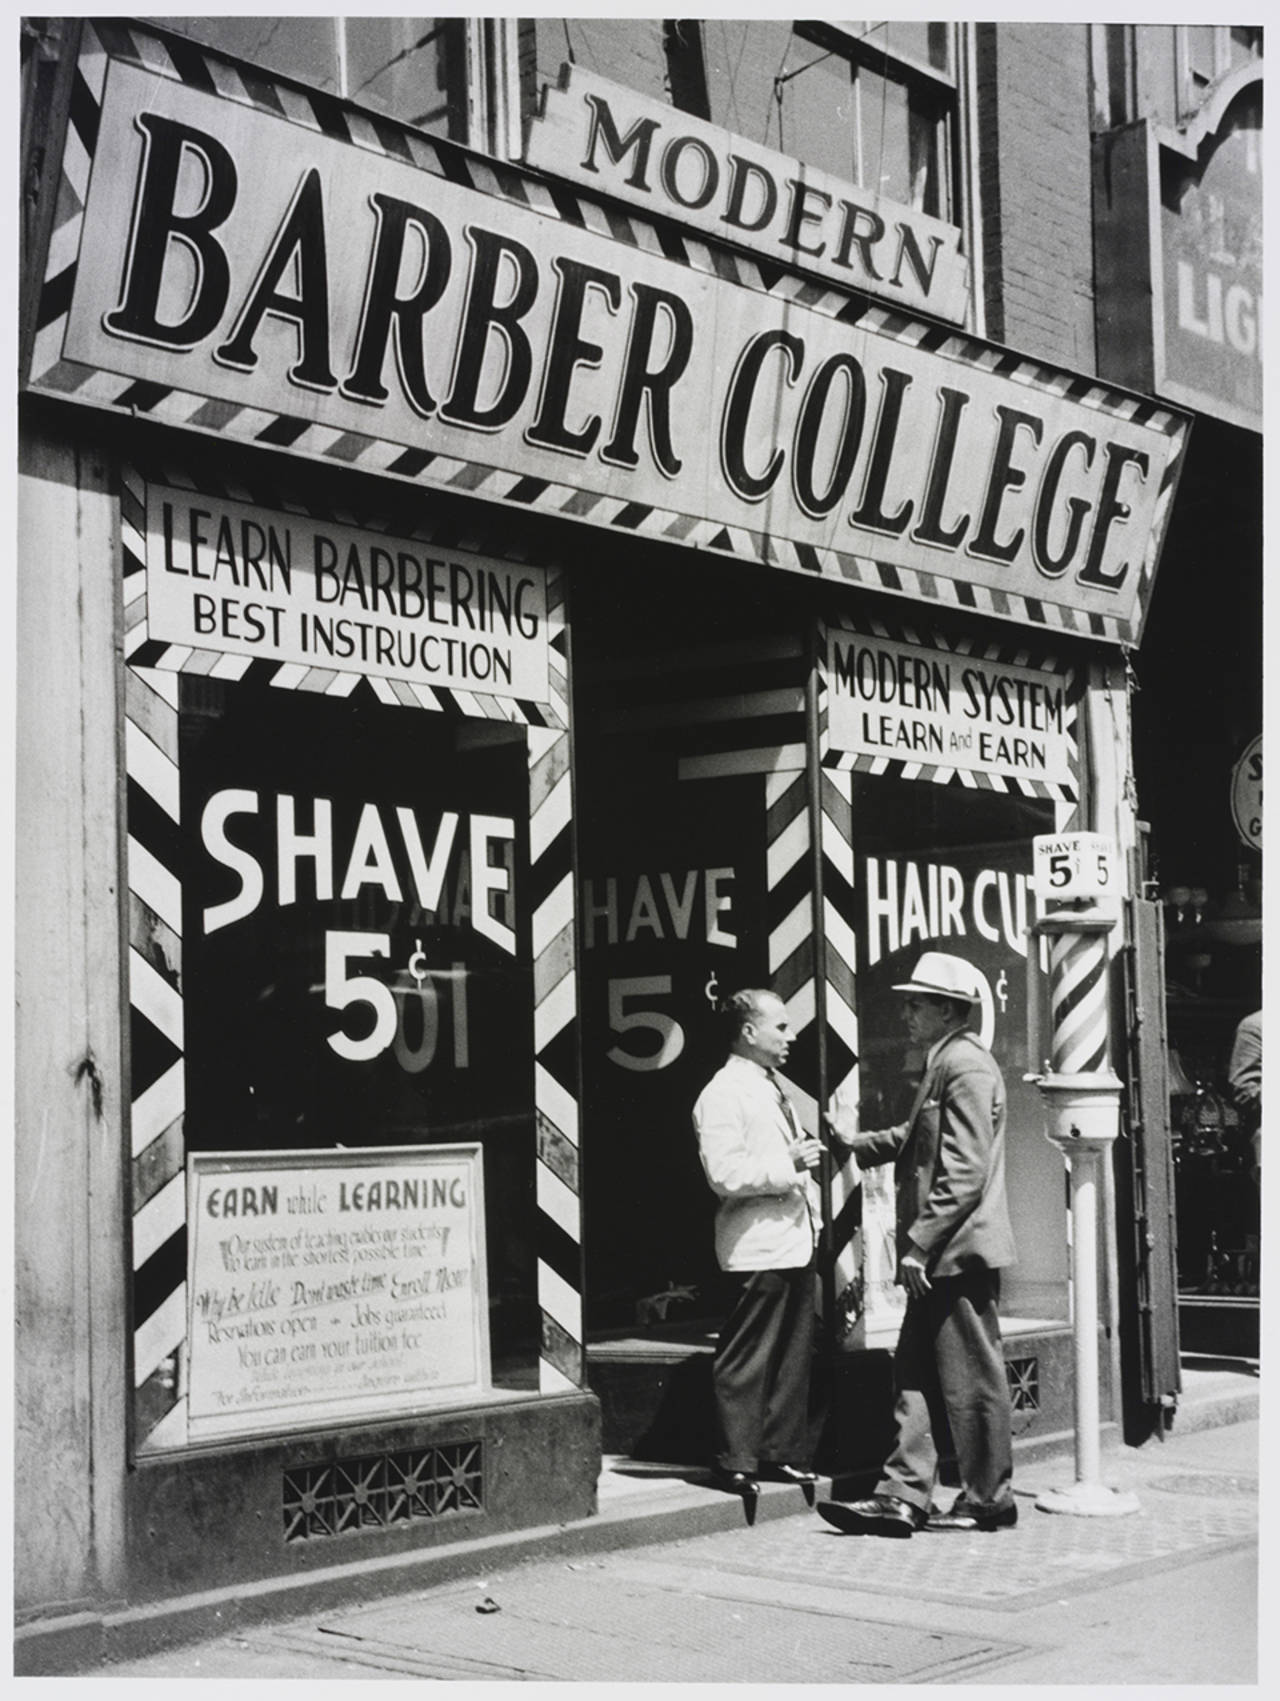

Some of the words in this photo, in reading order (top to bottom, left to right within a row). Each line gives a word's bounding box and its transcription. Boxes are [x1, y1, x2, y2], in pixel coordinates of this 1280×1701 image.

[581, 93, 944, 297] MODERN
[103, 112, 694, 478] BARBER
[720, 329, 1149, 591] COLLEGE
[1178, 260, 1263, 356] LIG
[162, 502, 291, 594] LEARN
[314, 535, 539, 639] BARBERING
[194, 594, 285, 647] BEST
[301, 613, 512, 684] INSTRUCTION
[834, 642, 950, 714] MODERN
[961, 668, 1063, 734] SYSTEM
[862, 712, 943, 753] LEARN
[950, 727, 972, 749] And
[979, 732, 1046, 769] EARN
[201, 789, 516, 956] SHAVE
[1038, 840, 1080, 855] SHAVE
[867, 857, 966, 966] HAIR
[207, 1186, 278, 1218] EARN
[287, 1184, 327, 1215] while
[339, 1178, 466, 1212] LEARNING
[303, 1247, 349, 1266] shortest
[237, 1344, 261, 1368] You
[264, 1346, 287, 1366] can
[290, 1343, 317, 1363] earn
[322, 1340, 350, 1359] your
[355, 1331, 398, 1356] tuition
[402, 1328, 422, 1350] fee
[281, 1315, 317, 1338] open
[350, 1302, 381, 1328] Jobs
